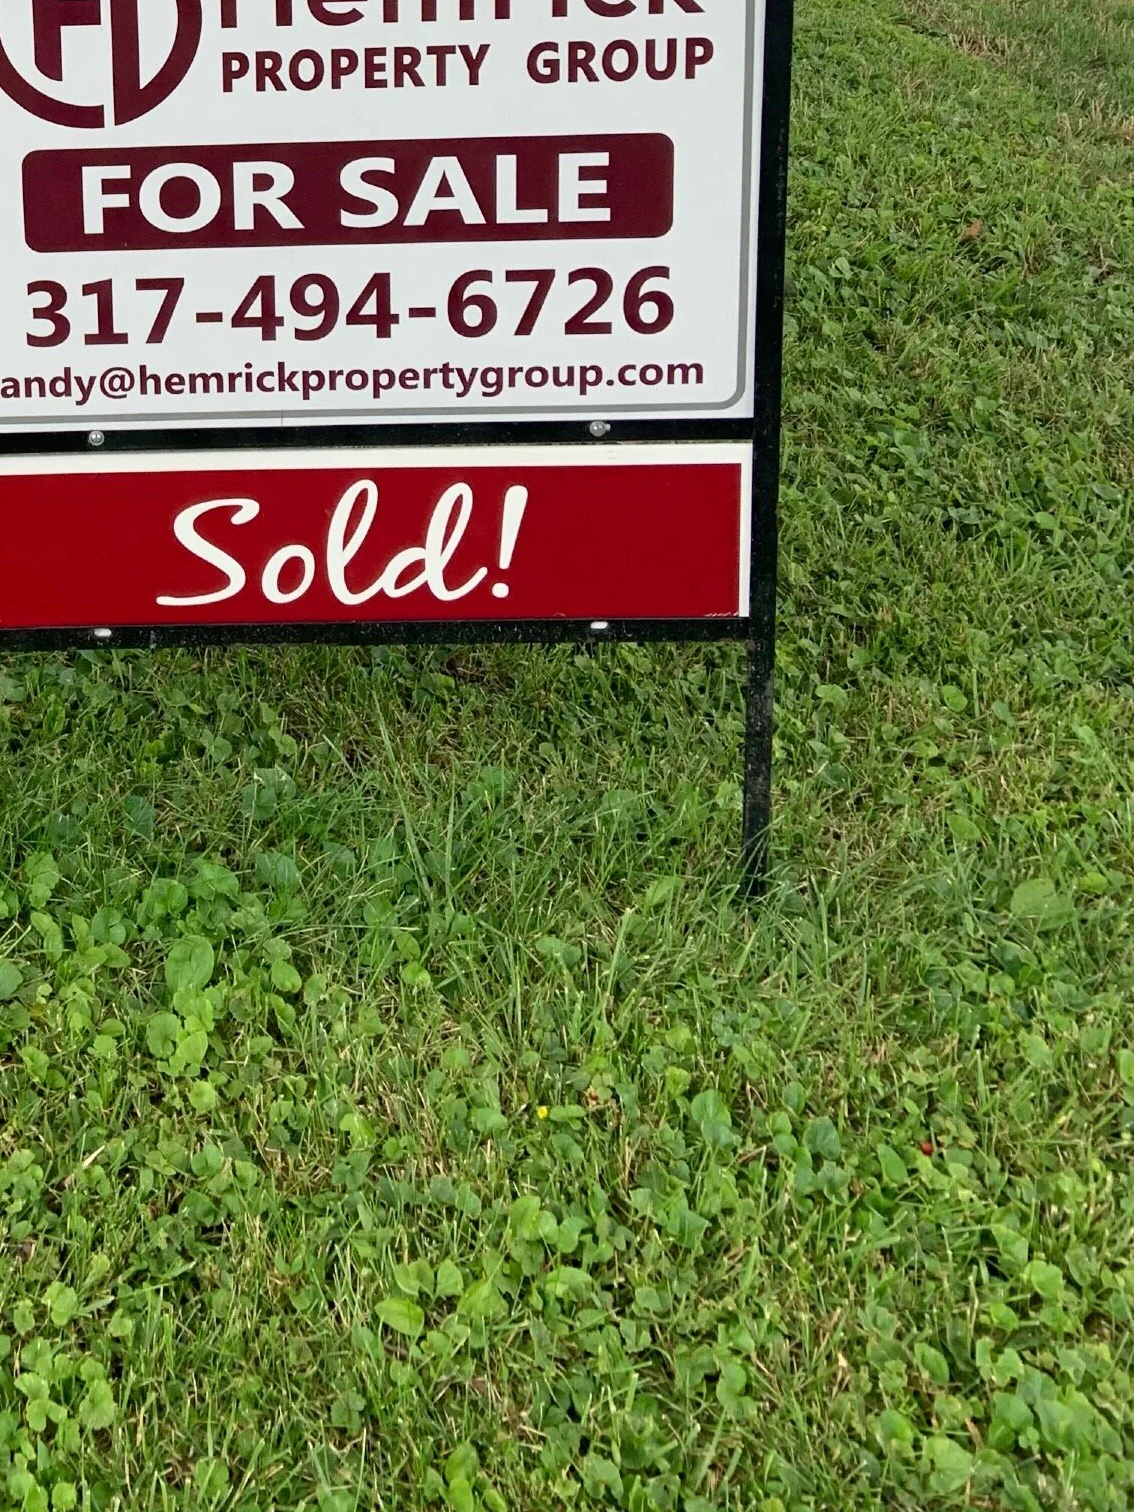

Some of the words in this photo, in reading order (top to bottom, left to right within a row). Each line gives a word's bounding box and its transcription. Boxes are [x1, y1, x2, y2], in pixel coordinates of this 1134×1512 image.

[220, 43, 492, 94] PROPERTY
[525, 36, 716, 85] GROUP
[80, 159, 306, 236] FOR
[338, 150, 612, 229] SALE
[25, 264, 676, 349] 317-494-6726
[0, 360, 705, 407] andy@hemrickpropertygroup.com
[155, 478, 530, 607] Sold!
